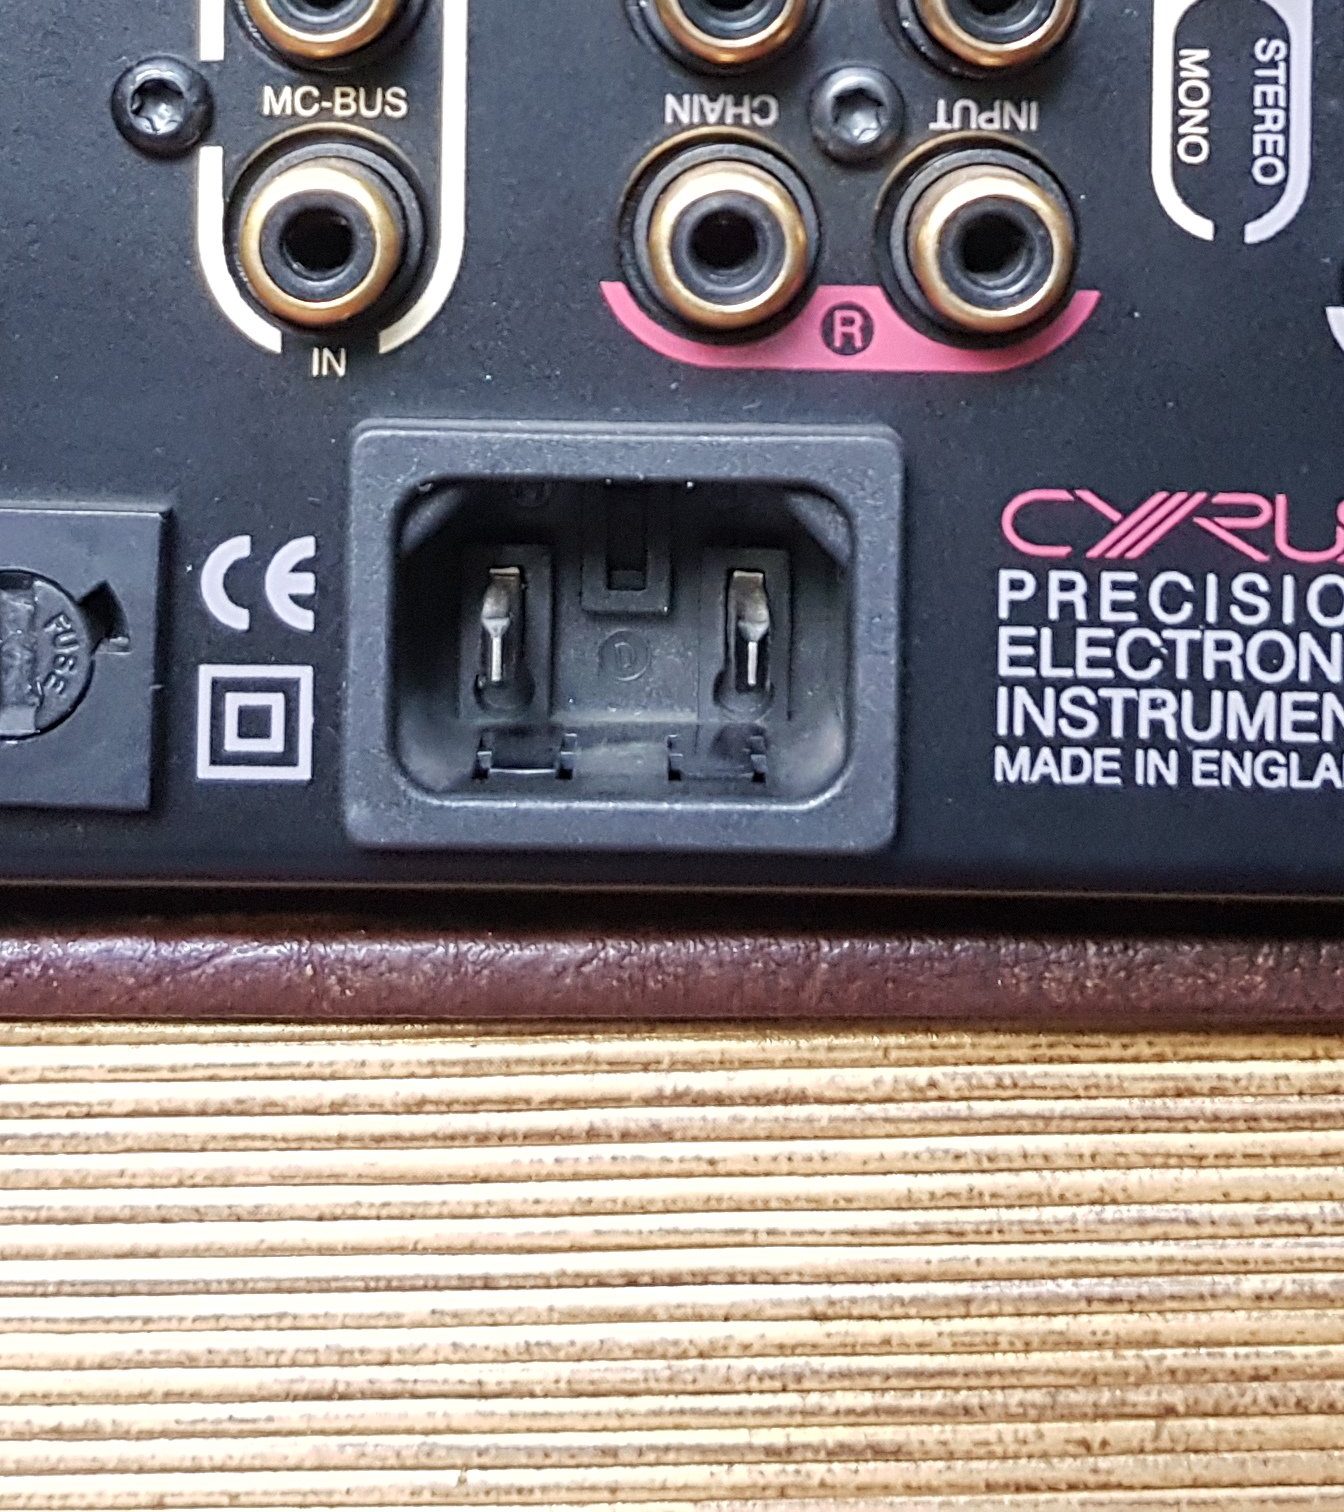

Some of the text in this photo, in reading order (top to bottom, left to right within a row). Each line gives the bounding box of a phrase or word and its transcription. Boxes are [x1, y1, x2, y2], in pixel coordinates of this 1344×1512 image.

[263, 86, 407, 118] MC-BUS
[665, 94, 779, 126] CHAIN
[930, 99, 1037, 130] INPUT
[1177, 48, 1212, 164] MONO
[1252, 38, 1288, 185] STEREO
[834, 310, 863, 346] R
[311, 348, 345, 376] IN
[994, 747, 1122, 786] MADE
[1135, 748, 1178, 786] IN
